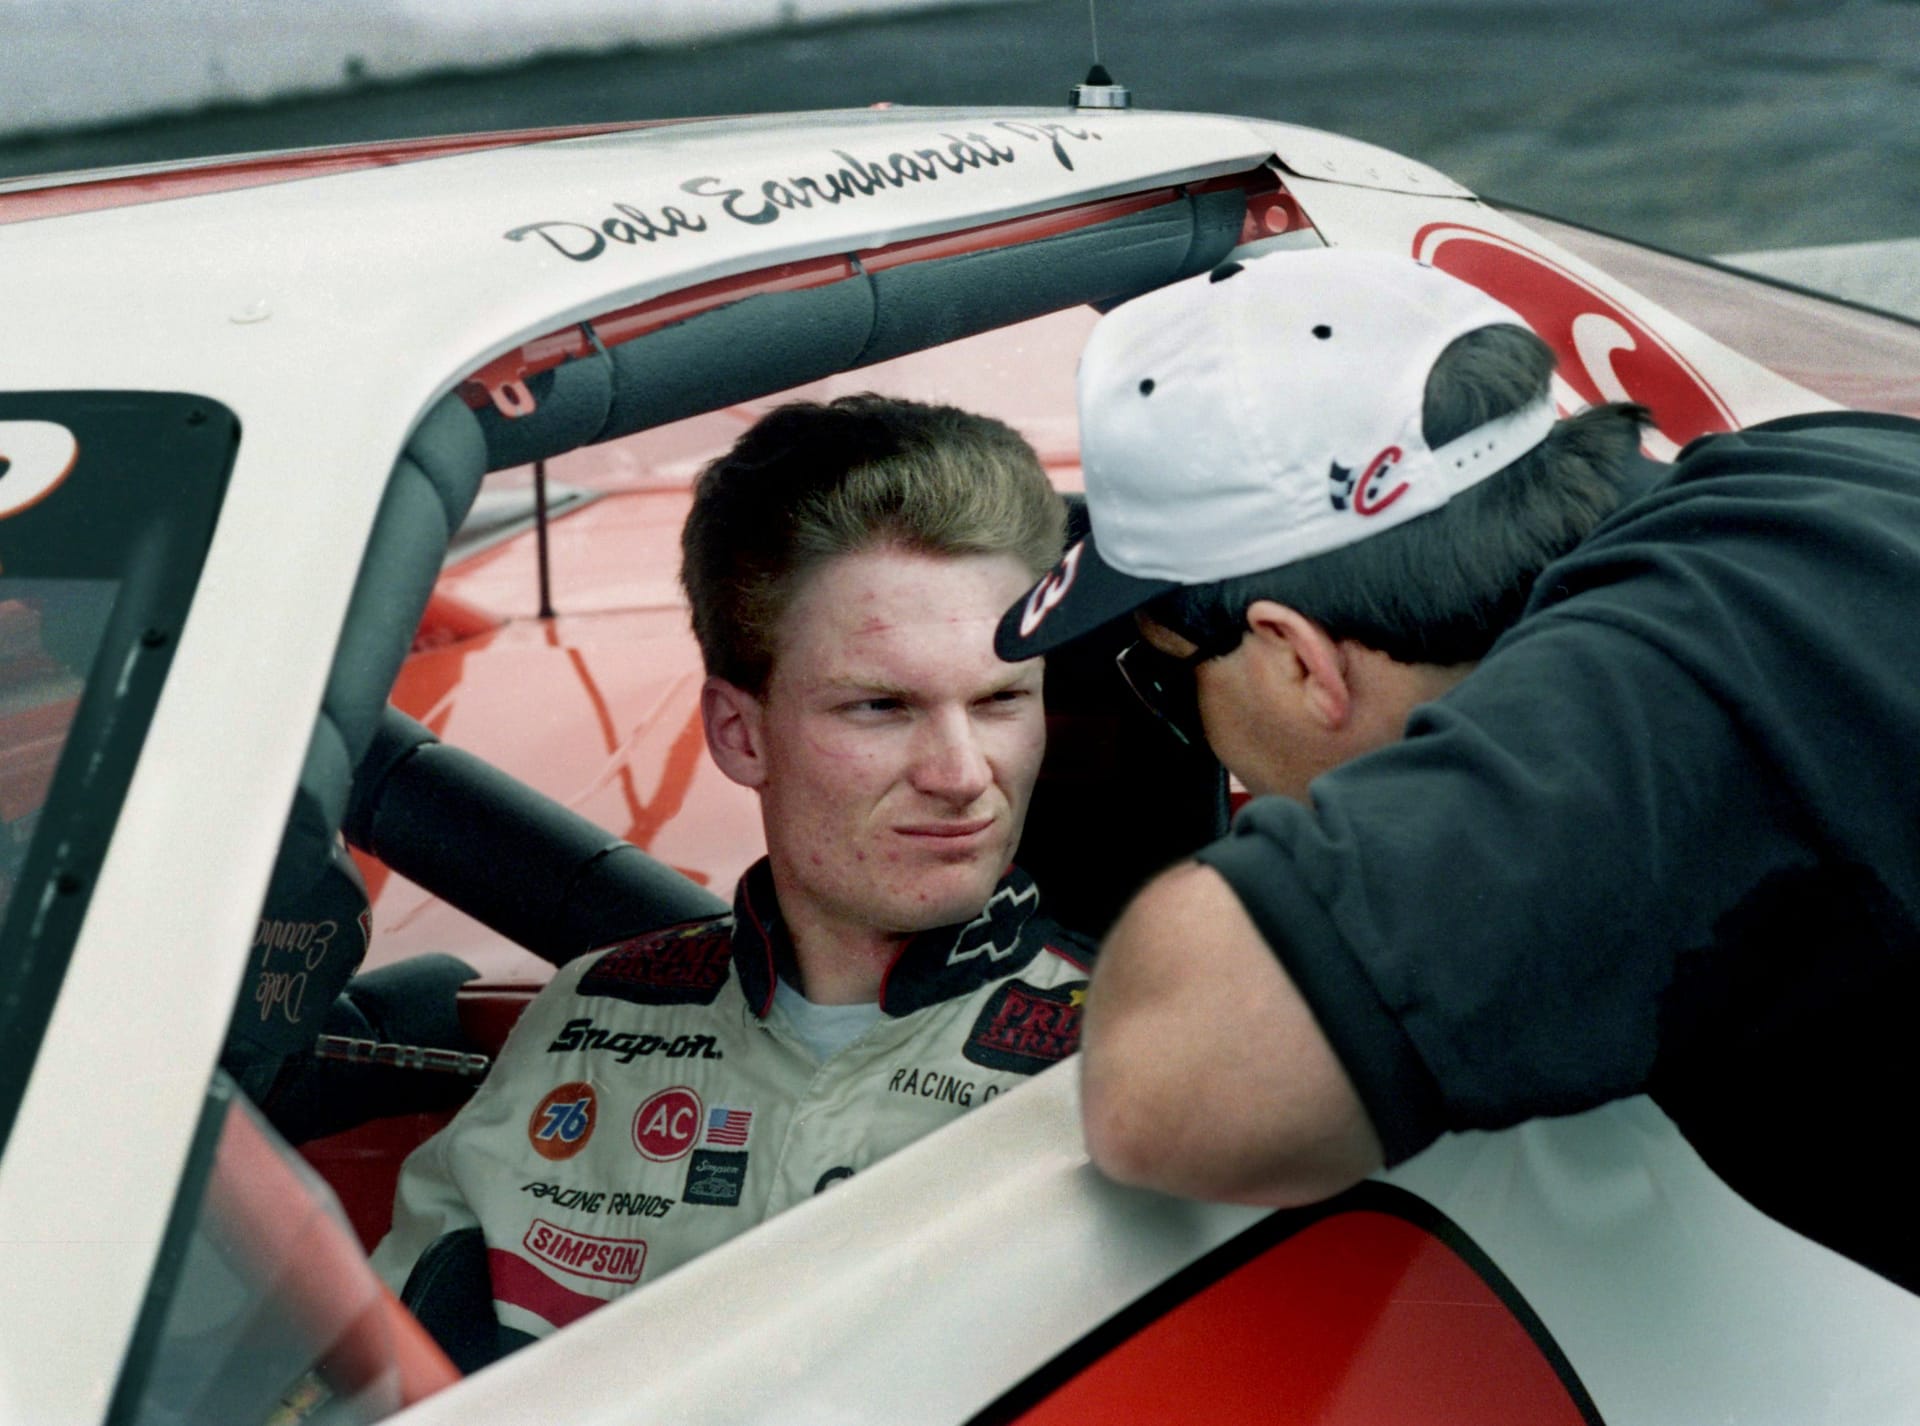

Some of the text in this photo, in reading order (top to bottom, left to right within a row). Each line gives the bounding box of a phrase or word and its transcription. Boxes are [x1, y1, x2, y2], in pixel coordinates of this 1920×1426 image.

[502, 119, 1103, 262] Dale Earnhardt Jr.
[256, 971, 307, 1024] Dale
[888, 1068, 975, 1107] RACING
[536, 1098, 591, 1142] 76
[643, 1104, 694, 1140] AC
[521, 1182, 675, 1217] RACING RADIOS
[533, 1227, 640, 1275] SIMPSON
